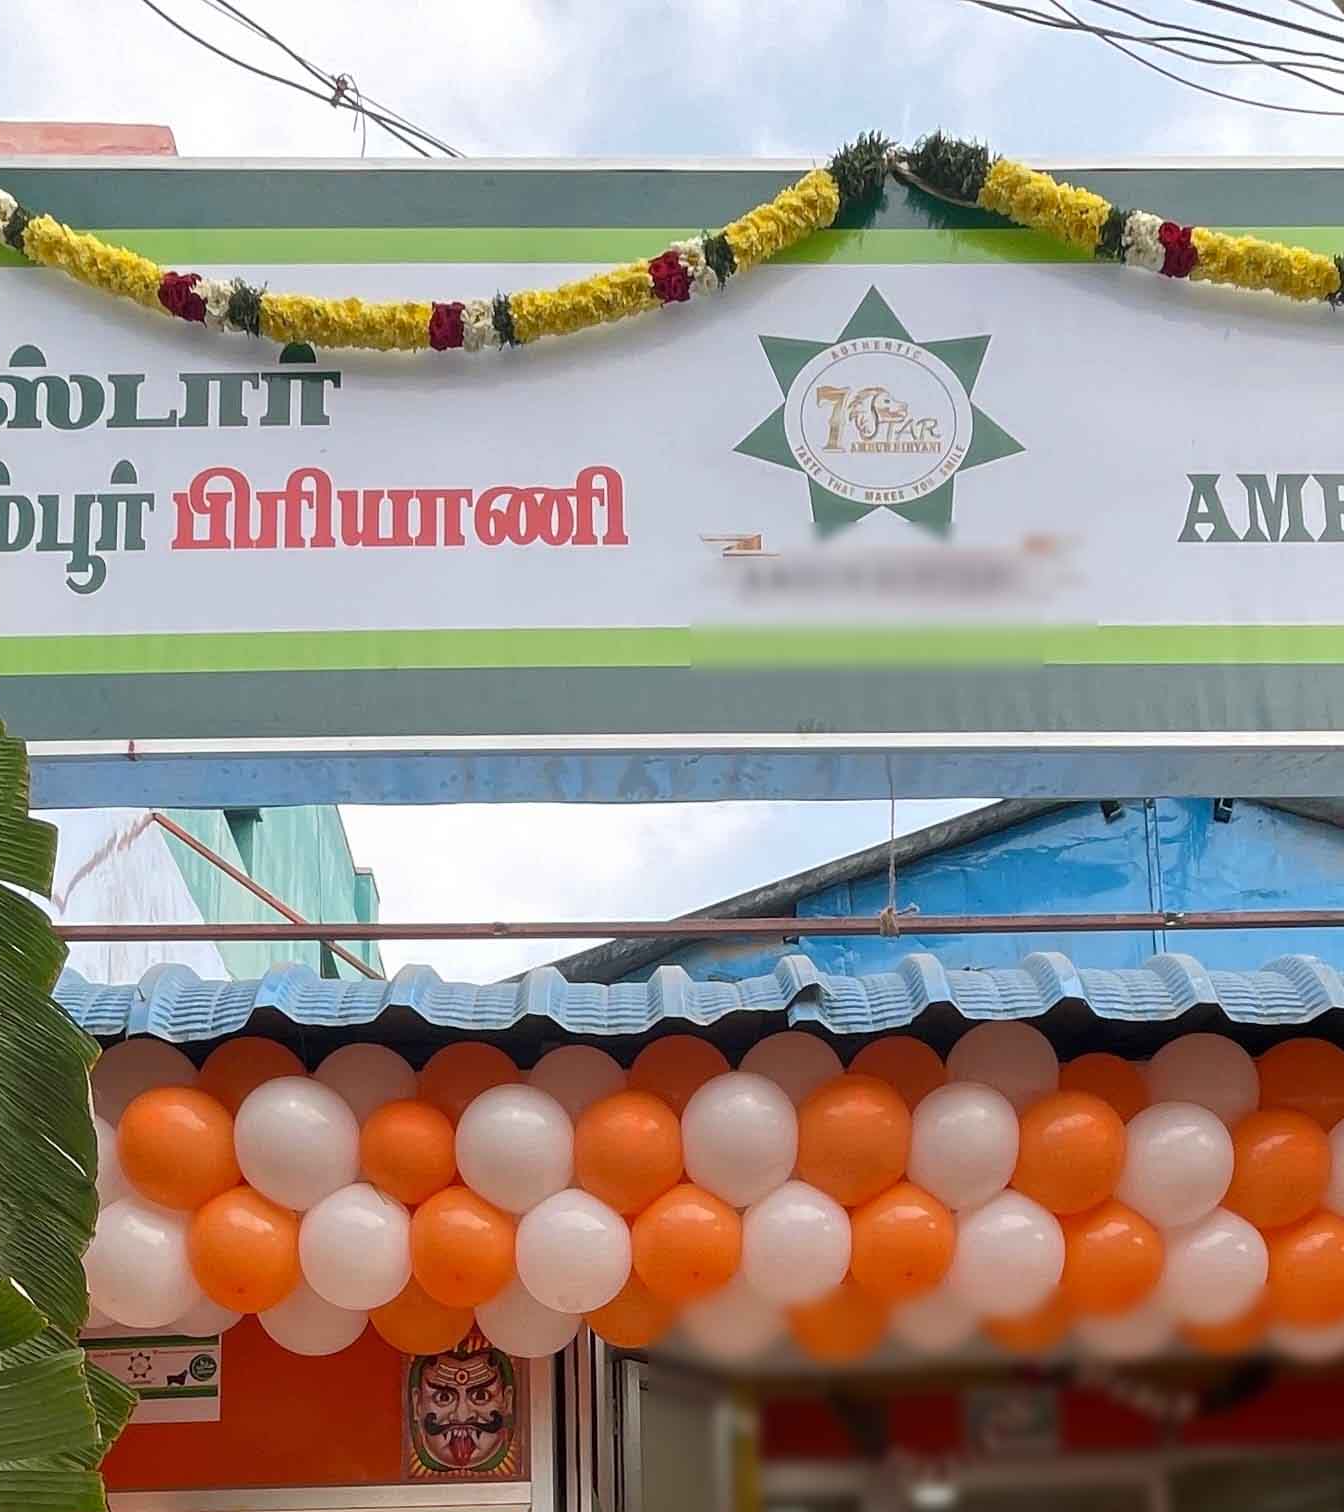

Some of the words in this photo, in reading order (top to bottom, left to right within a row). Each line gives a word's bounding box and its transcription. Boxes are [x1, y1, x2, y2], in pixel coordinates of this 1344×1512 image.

[831, 340, 922, 360] AUTHENTIC
[816, 385, 851, 454] 7
[794, 445, 823, 477] TASTE
[827, 479, 855, 498] THAT
[864, 489, 905, 502] MAKES
[940, 446, 965, 477] SMILE
[172, 466, 629, 551] பிரியாணி
